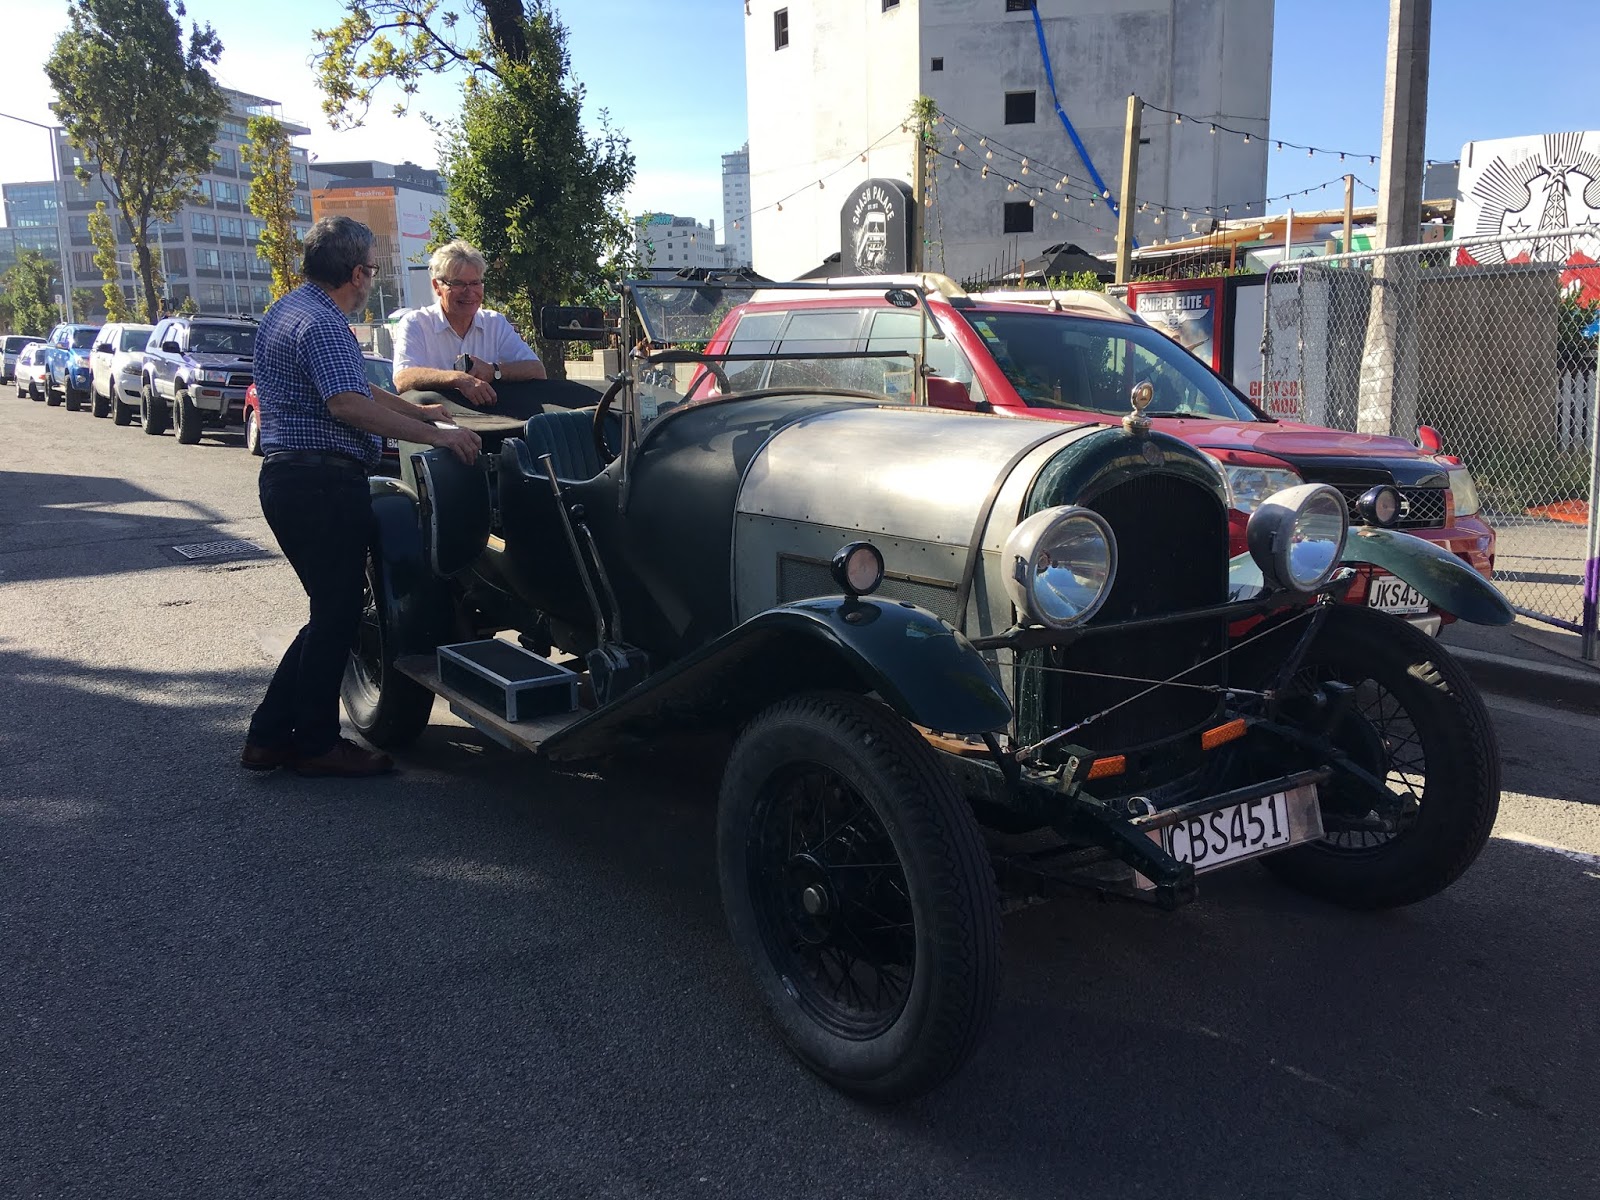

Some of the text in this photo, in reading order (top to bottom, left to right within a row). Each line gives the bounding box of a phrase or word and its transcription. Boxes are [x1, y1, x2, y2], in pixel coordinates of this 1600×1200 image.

[853, 186, 895, 225] SMASH PALACE
[1140, 294, 1211, 312] SNIPER ELITE 4
[1168, 795, 1282, 864] CBS451
